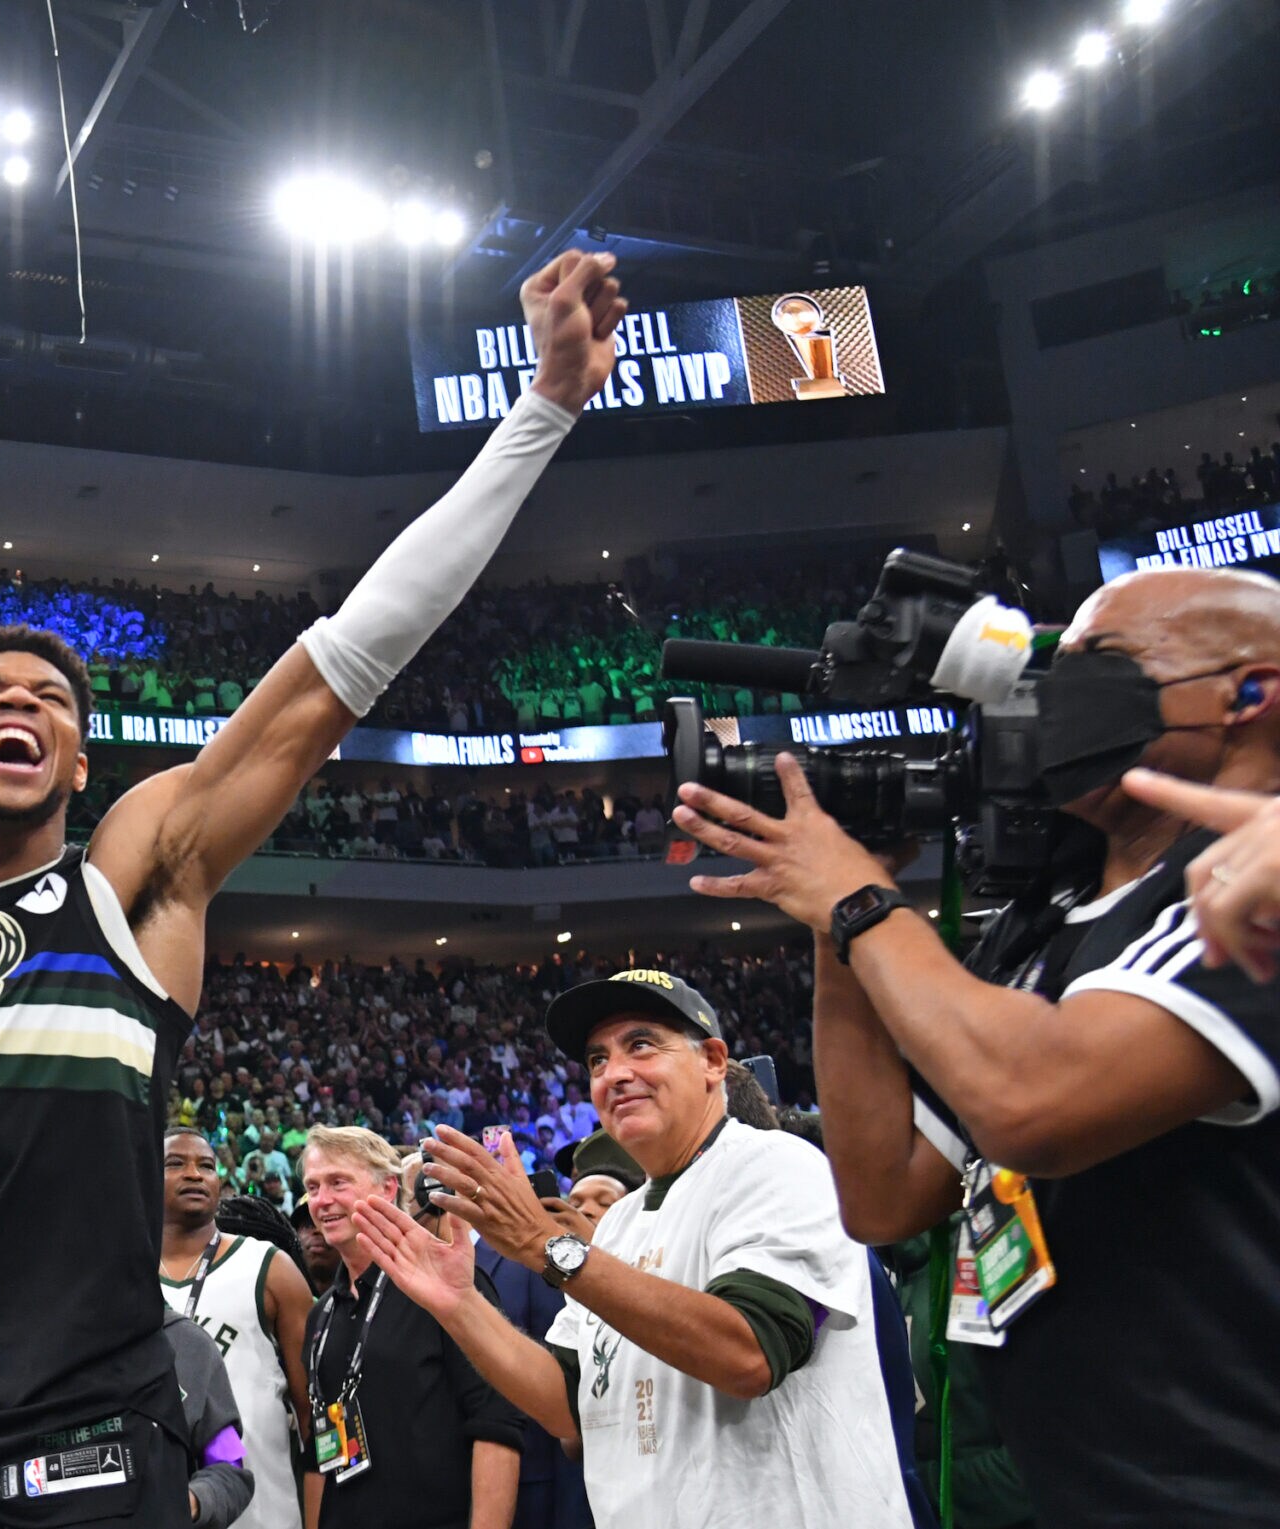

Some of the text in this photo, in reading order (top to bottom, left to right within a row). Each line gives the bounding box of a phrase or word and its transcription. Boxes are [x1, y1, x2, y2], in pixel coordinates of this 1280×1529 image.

[476, 325, 539, 369] BILL
[434, 371, 512, 423] NBA
[652, 351, 732, 404] MVP
[1156, 511, 1264, 553] BILL RUSSELL
[1179, 537, 1248, 569] FINALS
[1249, 528, 1280, 558] MV
[121, 715, 156, 742] NBA
[159, 717, 217, 745] FINALS
[790, 708, 945, 743] BILL RUSSELL NBA
[459, 735, 515, 766] FINALS
[635, 1378, 653, 1399] 20
[70, 1426, 91, 1444] THE
[91, 1416, 122, 1436] DEER
